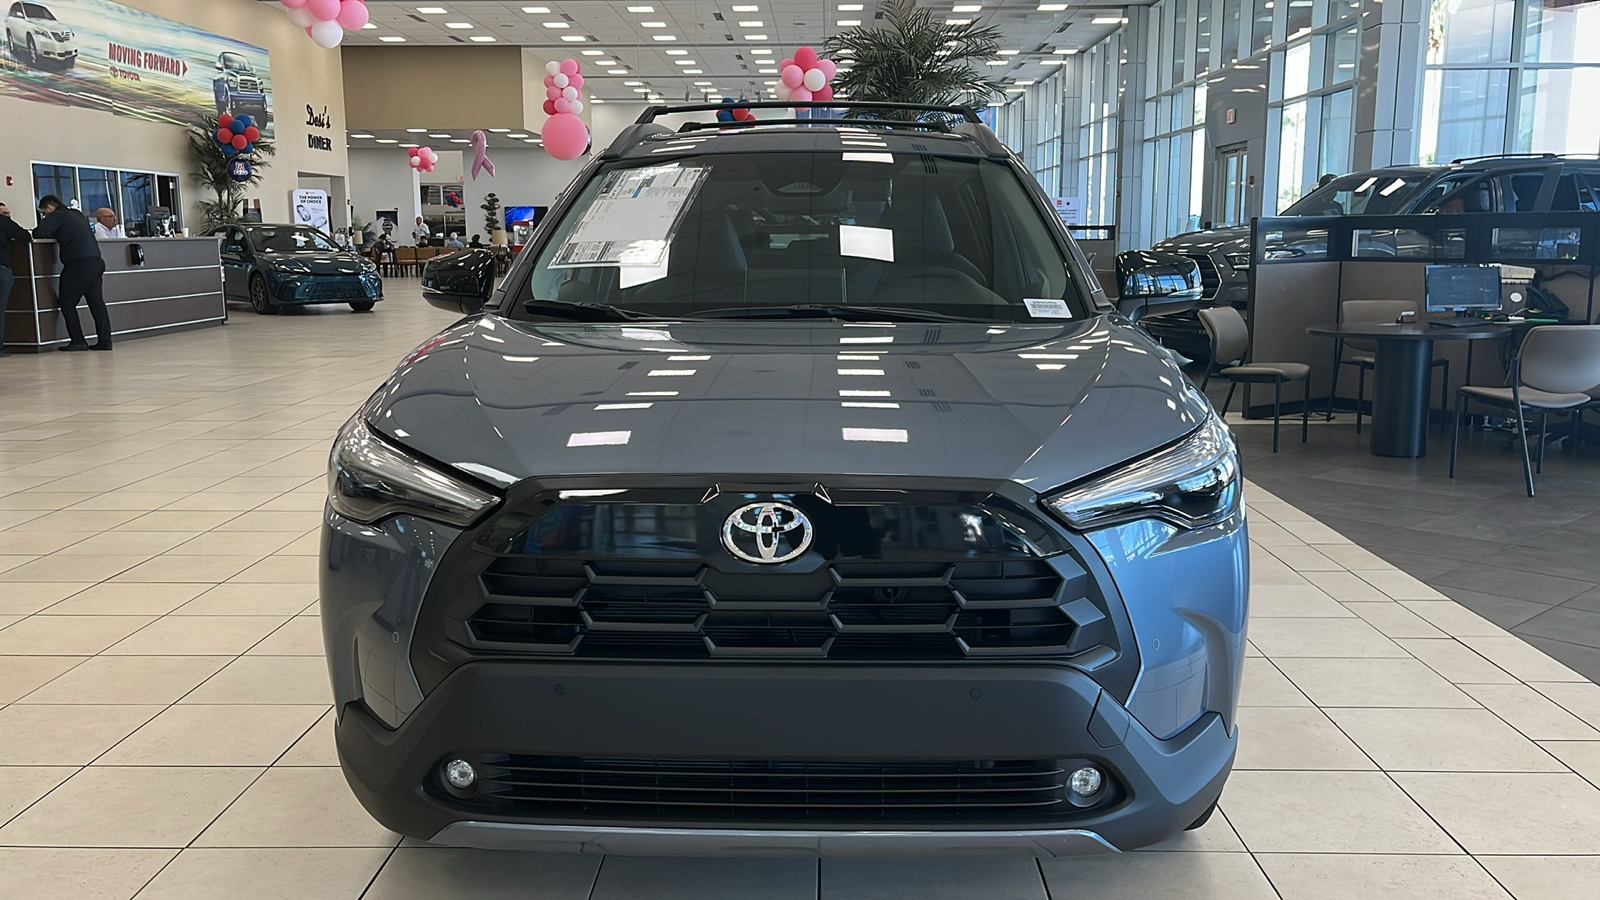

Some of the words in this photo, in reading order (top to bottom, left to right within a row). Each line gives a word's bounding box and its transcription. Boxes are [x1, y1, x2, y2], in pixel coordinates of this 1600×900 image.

[109, 43, 142, 67] MOVING
[144, 52, 180, 76] FORWARD
[119, 69, 141, 82] TOYOTA
[306, 104, 331, 129] Desi's
[307, 133, 332, 151] DINER
